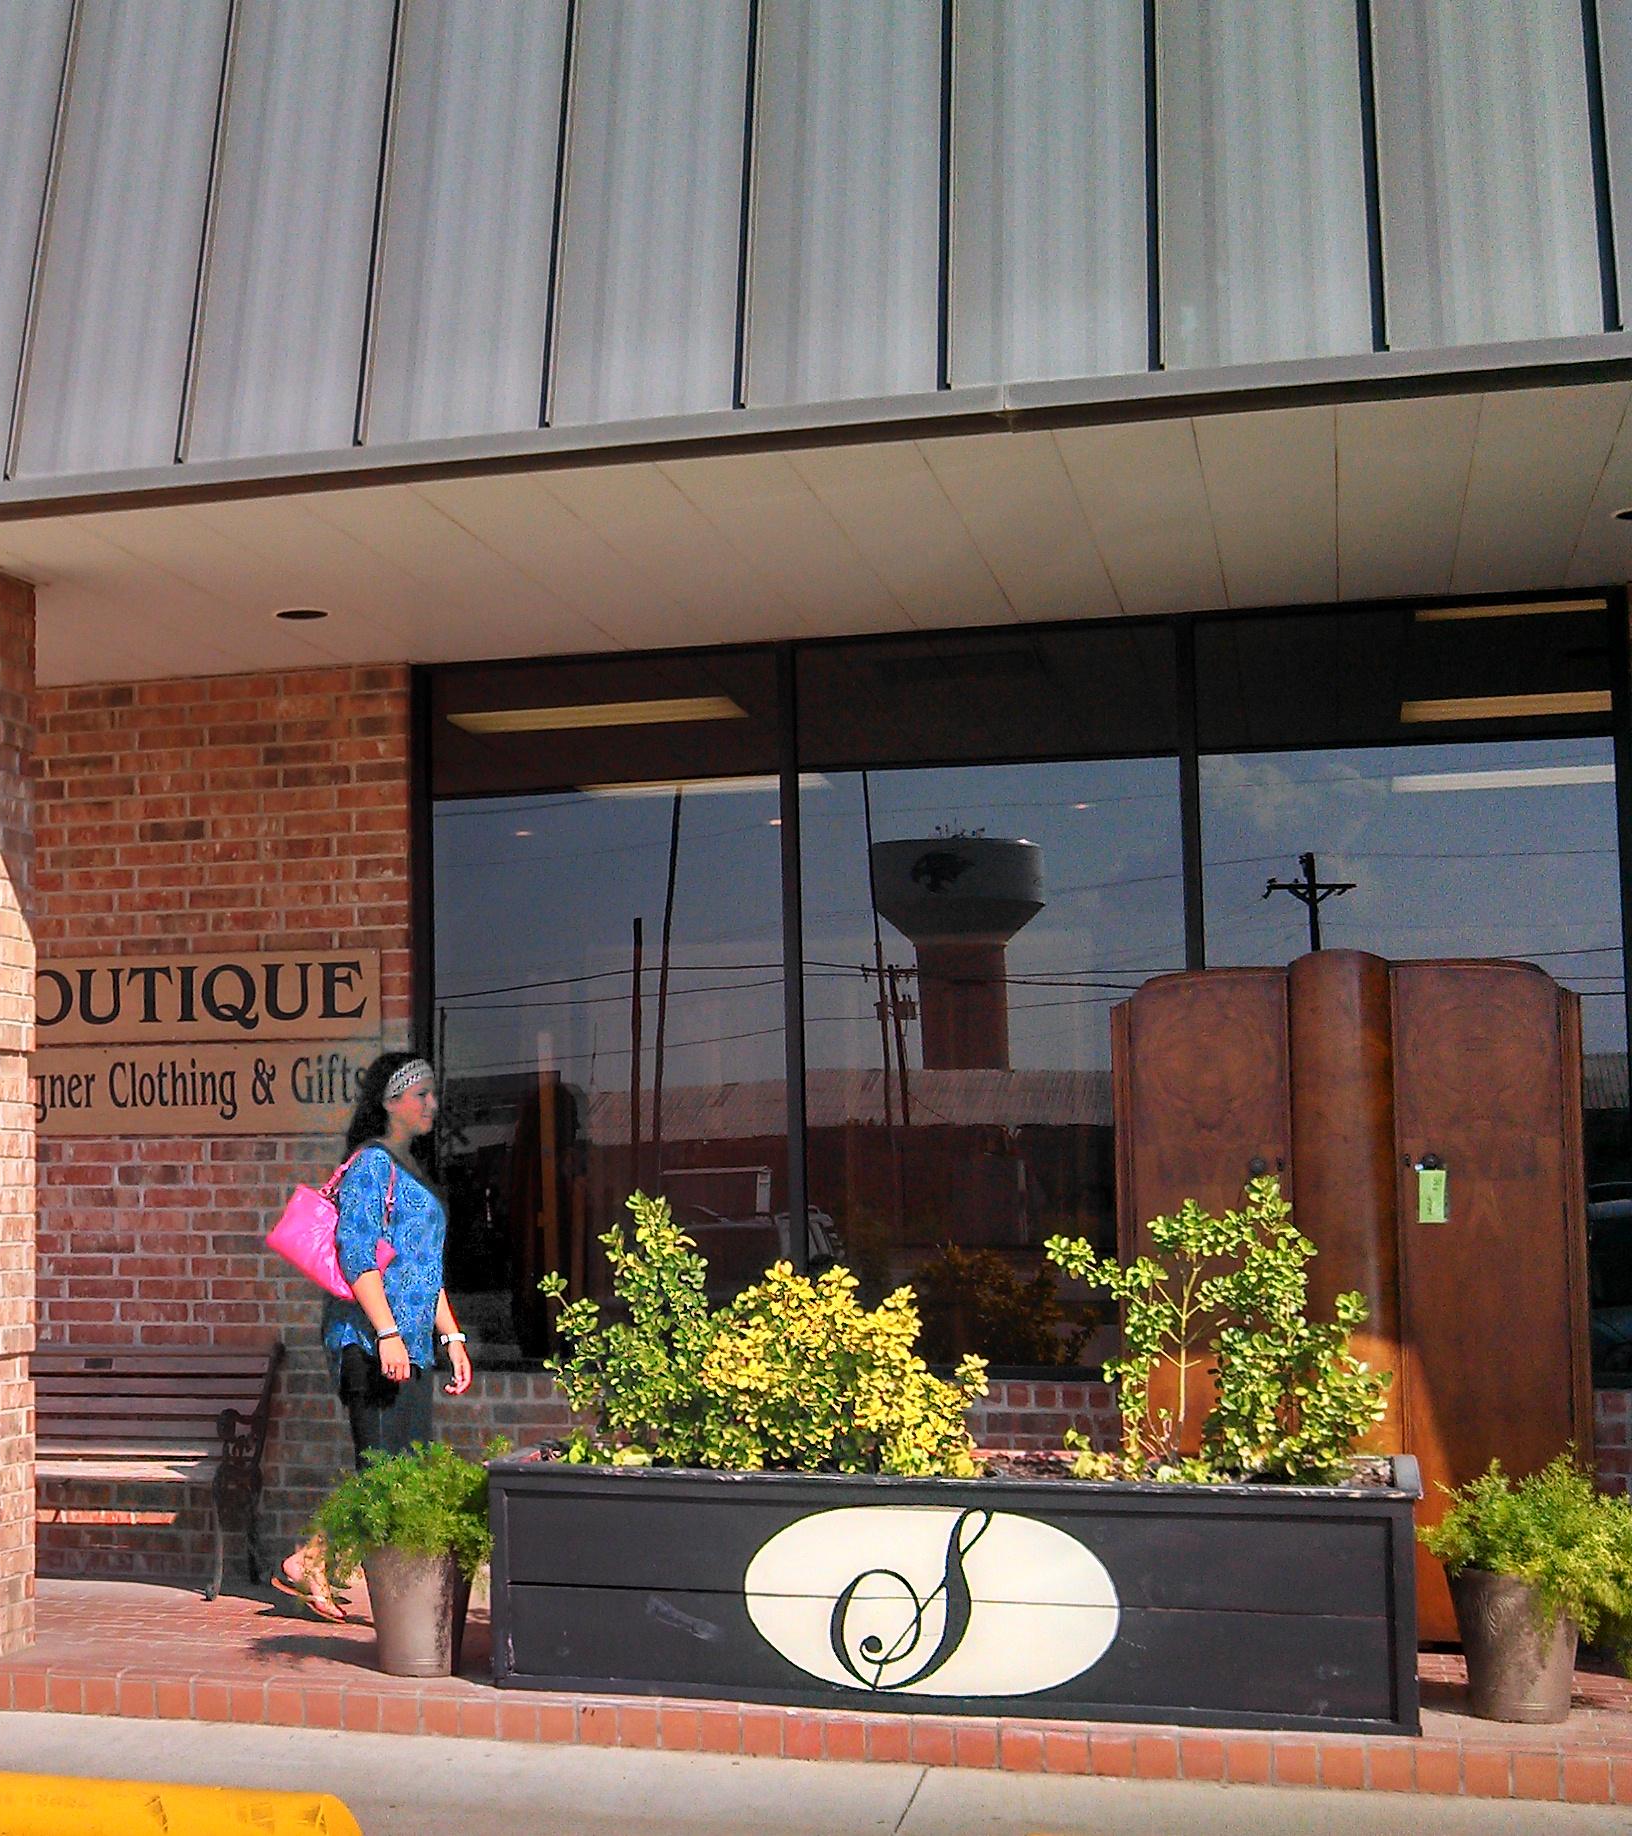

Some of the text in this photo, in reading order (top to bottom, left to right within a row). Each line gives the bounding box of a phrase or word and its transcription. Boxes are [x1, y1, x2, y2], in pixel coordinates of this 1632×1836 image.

[35, 960, 368, 1030] OUTIQUE
[108, 1057, 238, 1121] Clothing
[250, 1057, 277, 1106] &
[829, 1506, 995, 1692] S
